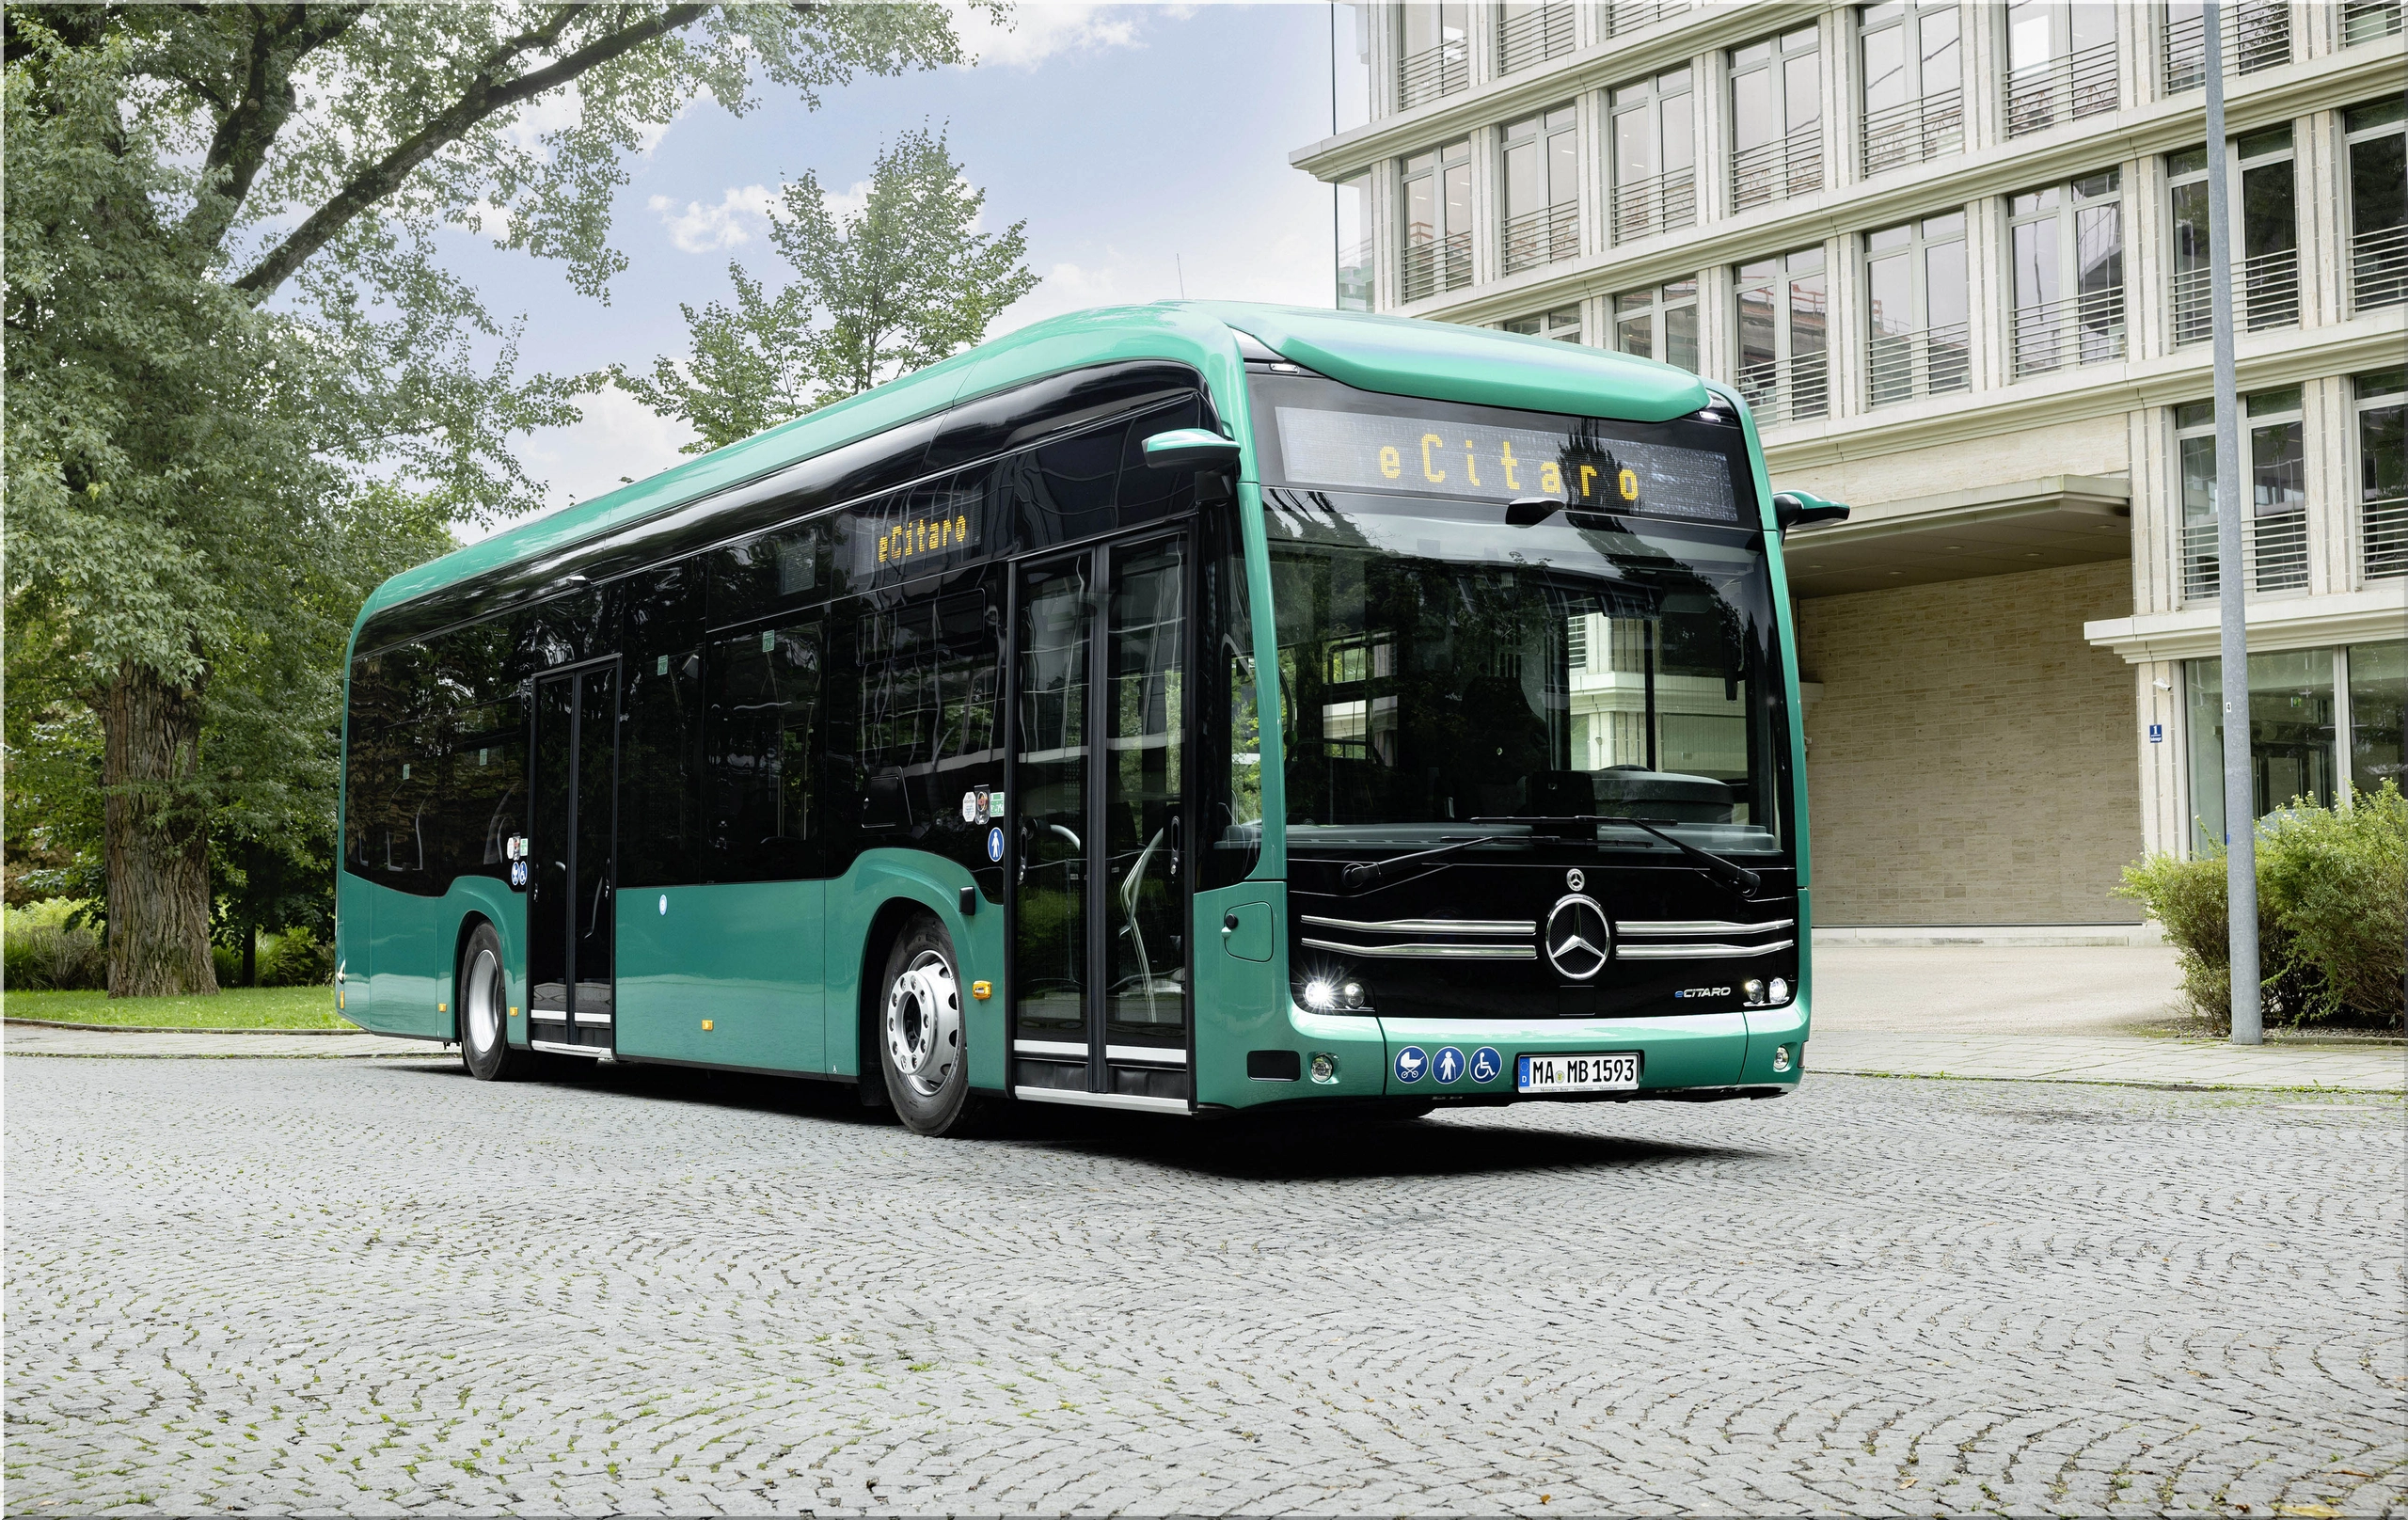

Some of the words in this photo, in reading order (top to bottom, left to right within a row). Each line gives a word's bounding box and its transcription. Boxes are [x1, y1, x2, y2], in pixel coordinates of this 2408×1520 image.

[1380, 434, 1639, 500] eCitaro
[879, 515, 966, 562] eCitaro
[1533, 1061, 1554, 1084] MA
[1567, 1060, 1589, 1083] MB
[1592, 1059, 1635, 1083] 1593
